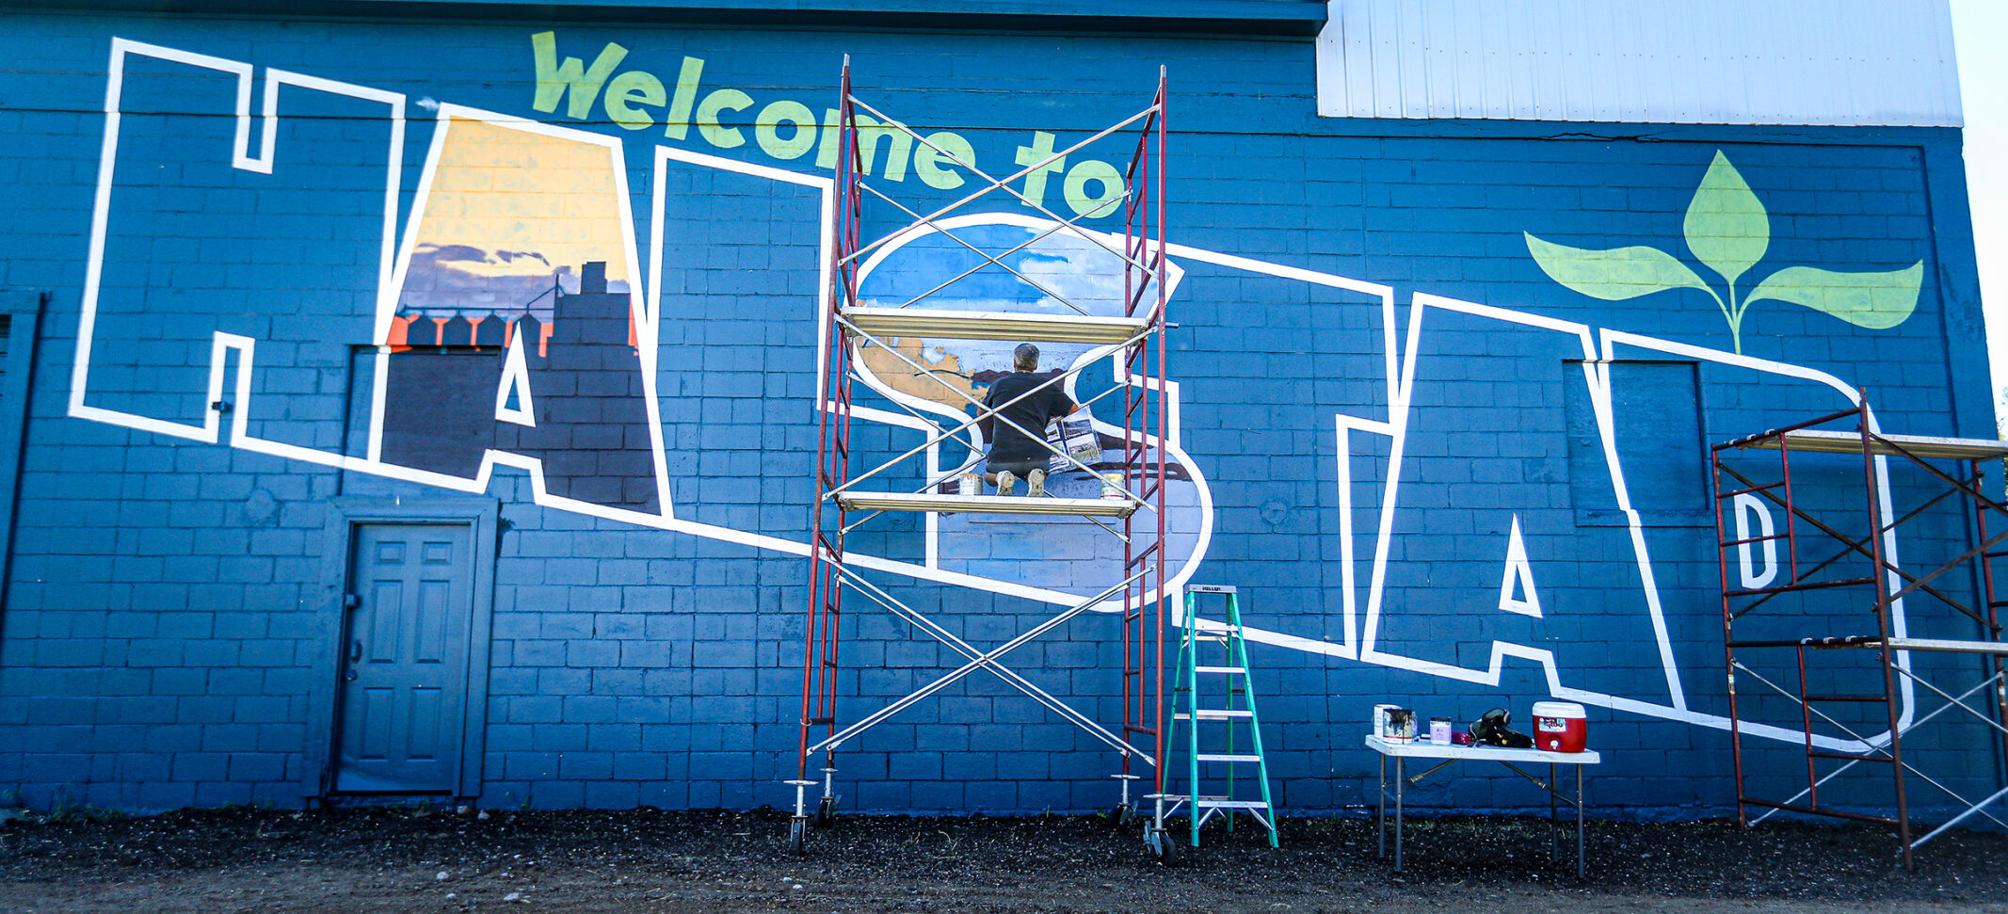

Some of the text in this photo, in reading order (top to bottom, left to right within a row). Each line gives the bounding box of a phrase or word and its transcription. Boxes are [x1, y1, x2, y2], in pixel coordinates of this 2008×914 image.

[531, 30, 1126, 219] Welcome to
[68, 37, 1916, 753] HALSTAD
